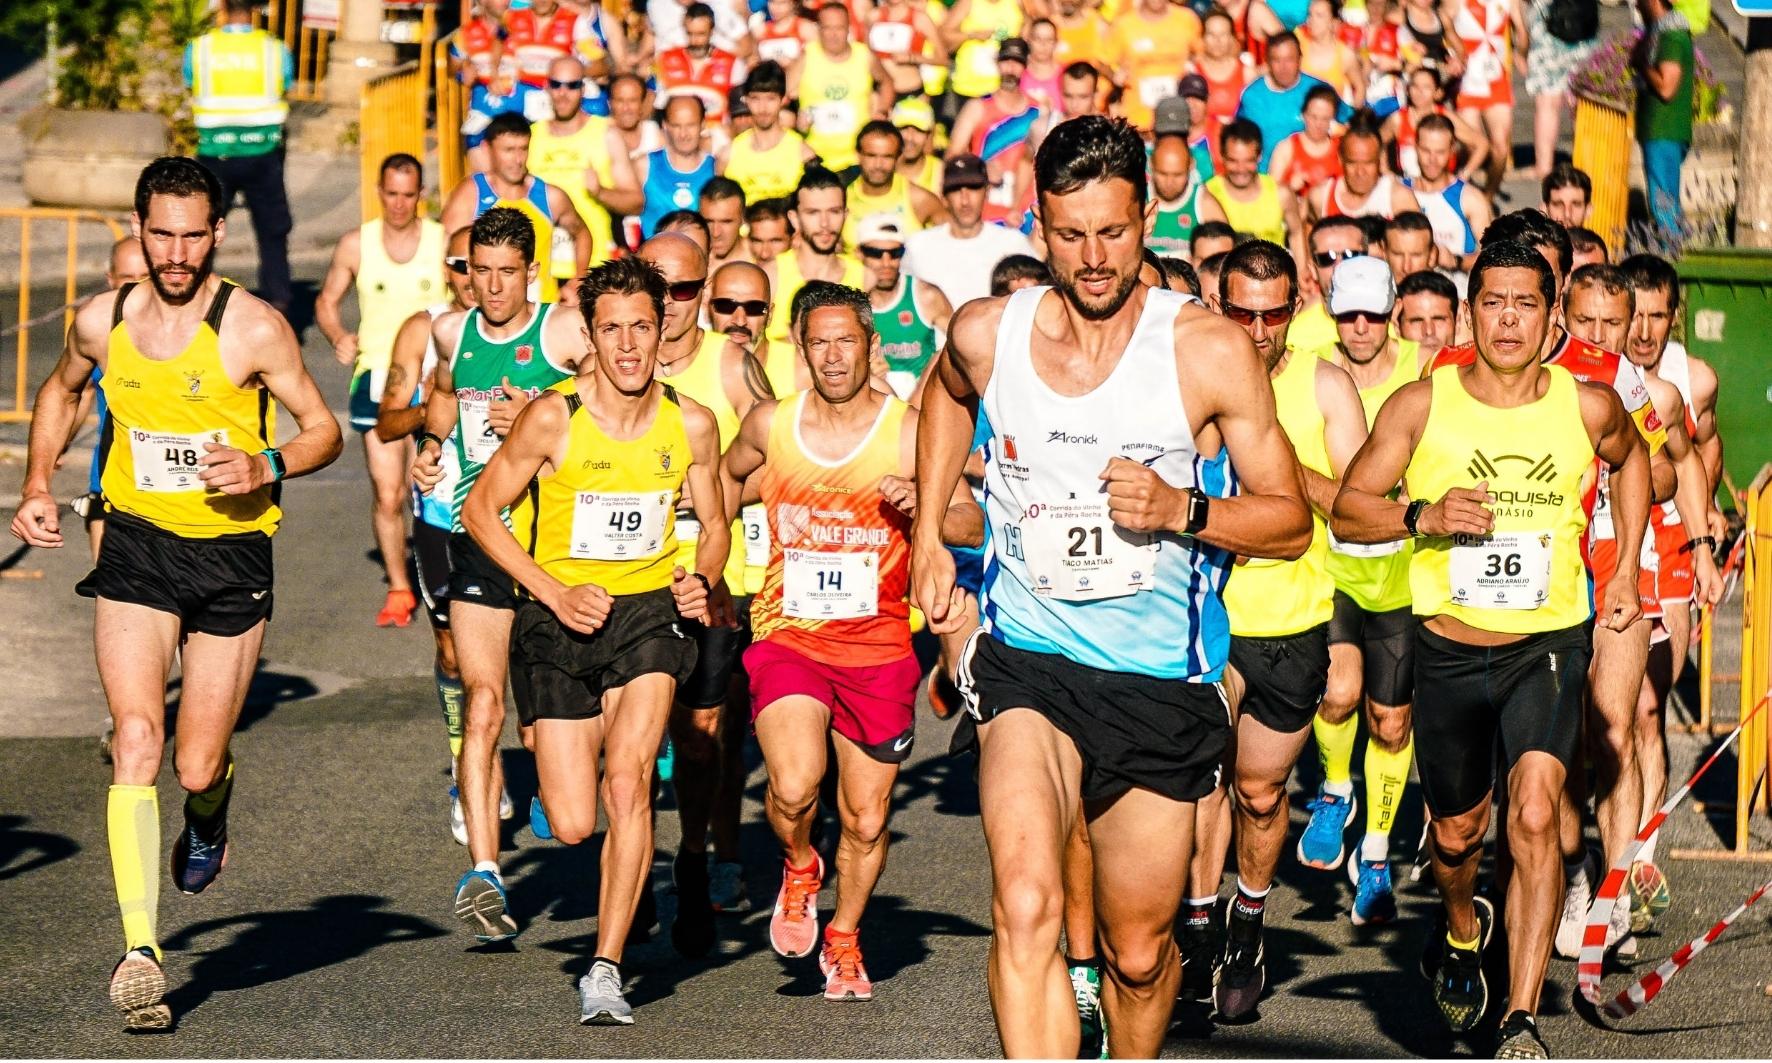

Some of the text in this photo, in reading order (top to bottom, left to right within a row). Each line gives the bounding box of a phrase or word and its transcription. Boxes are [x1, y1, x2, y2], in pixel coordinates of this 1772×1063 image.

[133, 431, 151, 442] 10ª
[1046, 430, 1098, 444] Aronick
[164, 448, 198, 467] 48
[579, 494, 600, 504] 10ª
[1486, 491, 1564, 507] nquista
[1491, 507, 1534, 518] INÁSIO
[609, 511, 642, 532] 49
[812, 525, 889, 545] VALE GRANDE
[1067, 526, 1102, 557] 21
[787, 551, 804, 562] 10ª
[1062, 558, 1113, 567] TIAGO MATIAS
[1484, 553, 1522, 577] 36
[816, 570, 842, 591] 14
